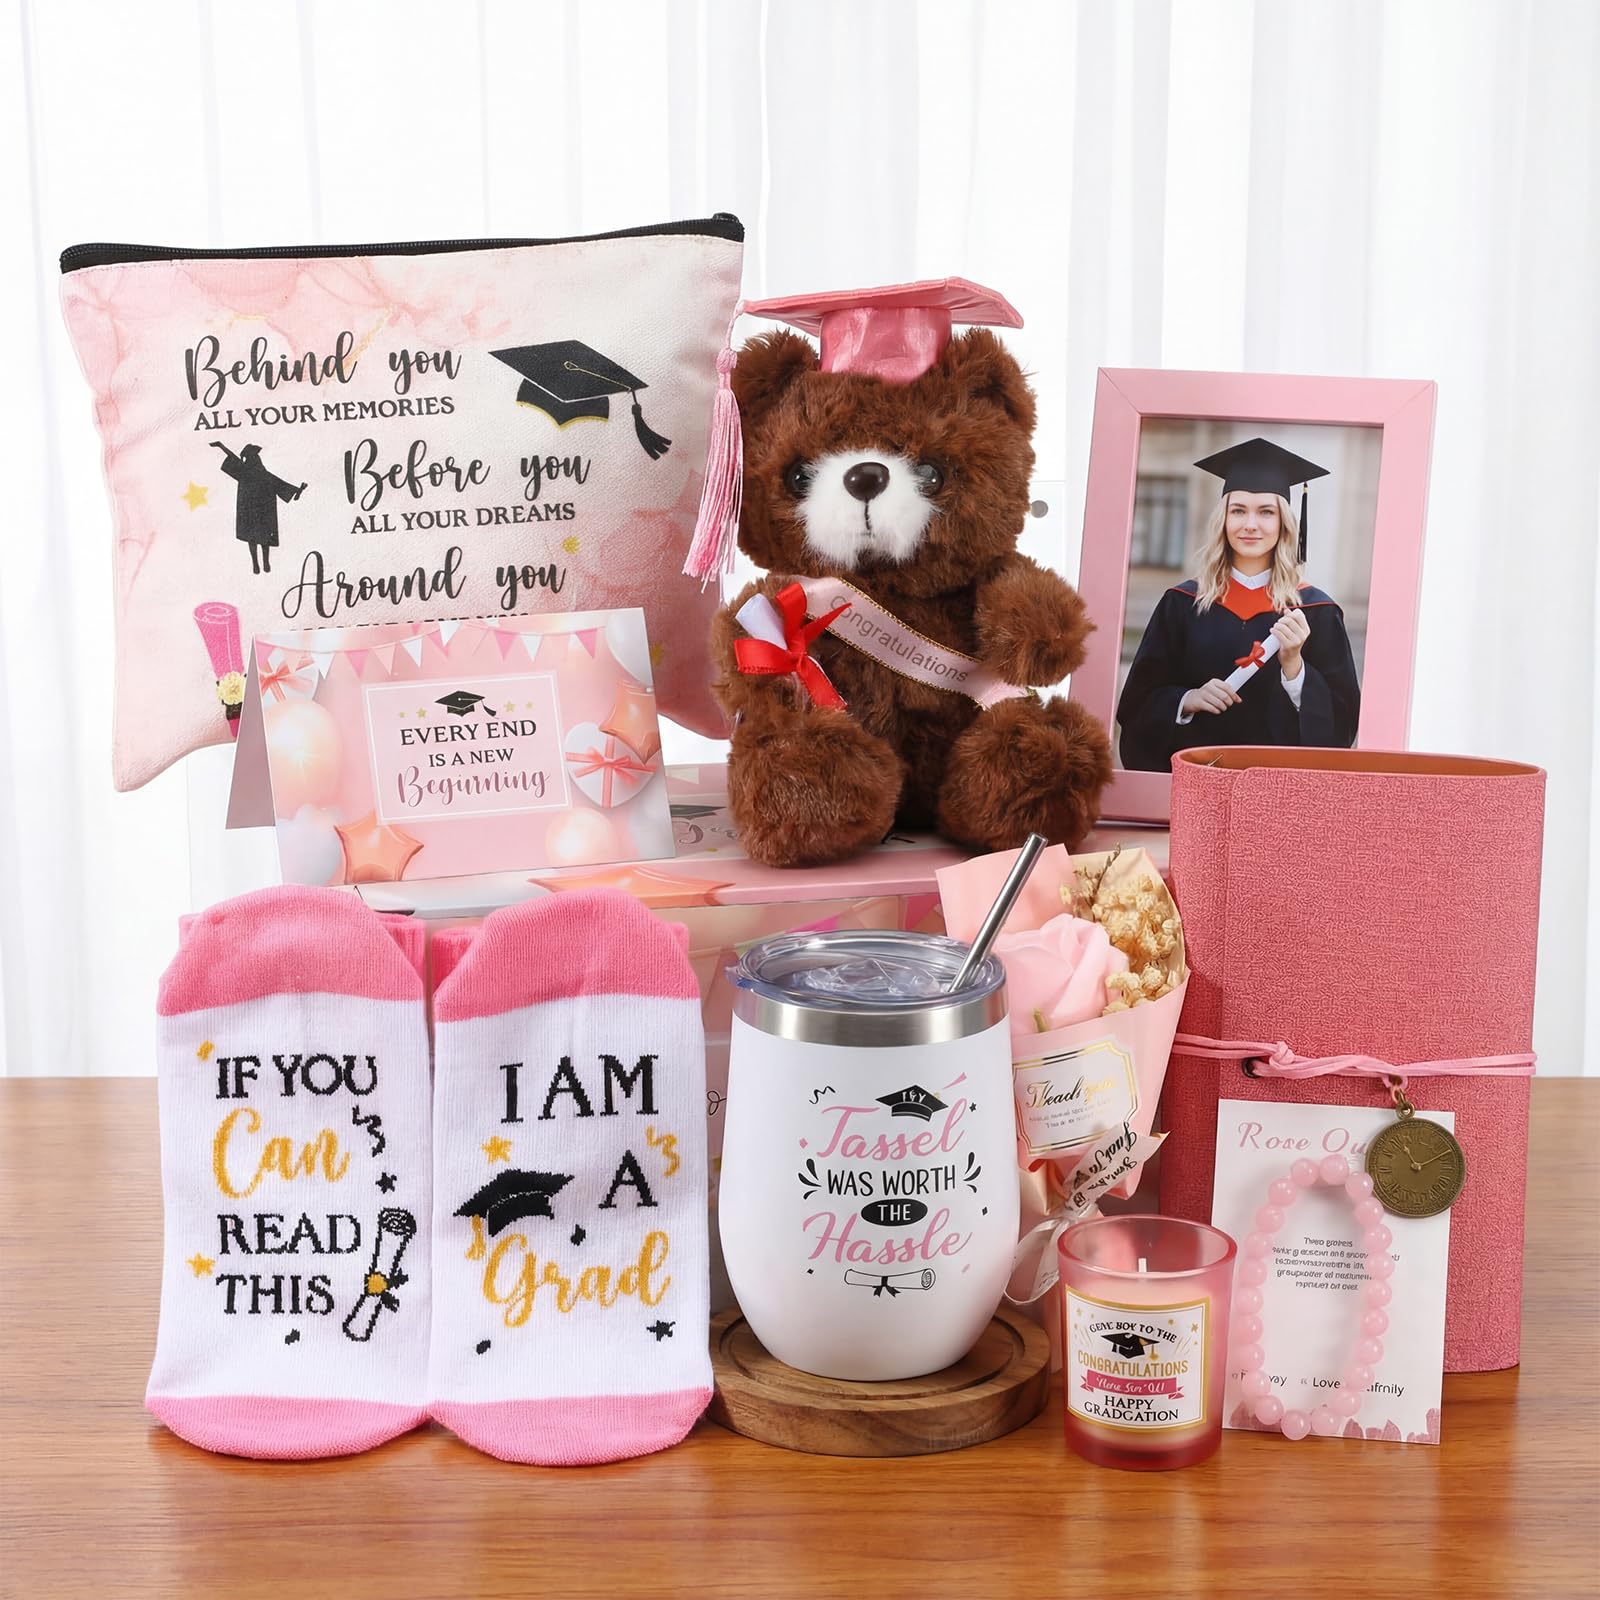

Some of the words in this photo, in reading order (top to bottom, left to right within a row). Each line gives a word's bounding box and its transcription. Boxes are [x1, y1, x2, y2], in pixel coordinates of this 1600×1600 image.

[184, 330, 358, 408] Behind
[388, 347, 463, 396] you
[194, 412, 241, 431] ALL
[243, 405, 318, 428] YOUR
[322, 396, 455, 423] MEMORIES
[344, 438, 491, 512] Before
[519, 454, 591, 501] you
[350, 515, 398, 535] ALL
[400, 509, 469, 532] YOUR
[475, 502, 576, 526] DREAMS
[281, 546, 466, 620] Around
[494, 562, 567, 611] you
[830, 595, 969, 683] Congratulations
[400, 723, 480, 747] EVERY
[486, 719, 537, 740] END
[428, 753, 446, 768] IS
[451, 751, 466, 766] A
[470, 747, 515, 764] NEW
[216, 1054, 262, 1099] IF
[272, 1053, 378, 1097] YOU
[499, 1062, 524, 1123] I
[538, 1054, 659, 1121] AM
[816, 1097, 968, 1162] Tassel
[1238, 1121, 1311, 1151] Rose
[212, 1106, 350, 1199] Can
[598, 1149, 659, 1209] A
[827, 1169, 875, 1197] WAS
[882, 1164, 957, 1196] WORTH
[217, 1212, 362, 1255] READ
[877, 1203, 913, 1222] THE
[802, 1207, 974, 1265] Hassle
[215, 1273, 335, 1316] THIS
[482, 1230, 672, 1328] Grad
[1139, 1324, 1154, 1334] TO
[1157, 1328, 1177, 1343] THE
[1077, 1350, 1188, 1377] CONGRATULATIONS
[1312, 1377, 1341, 1389] Love
[1104, 1395, 1154, 1410] HAPPY
